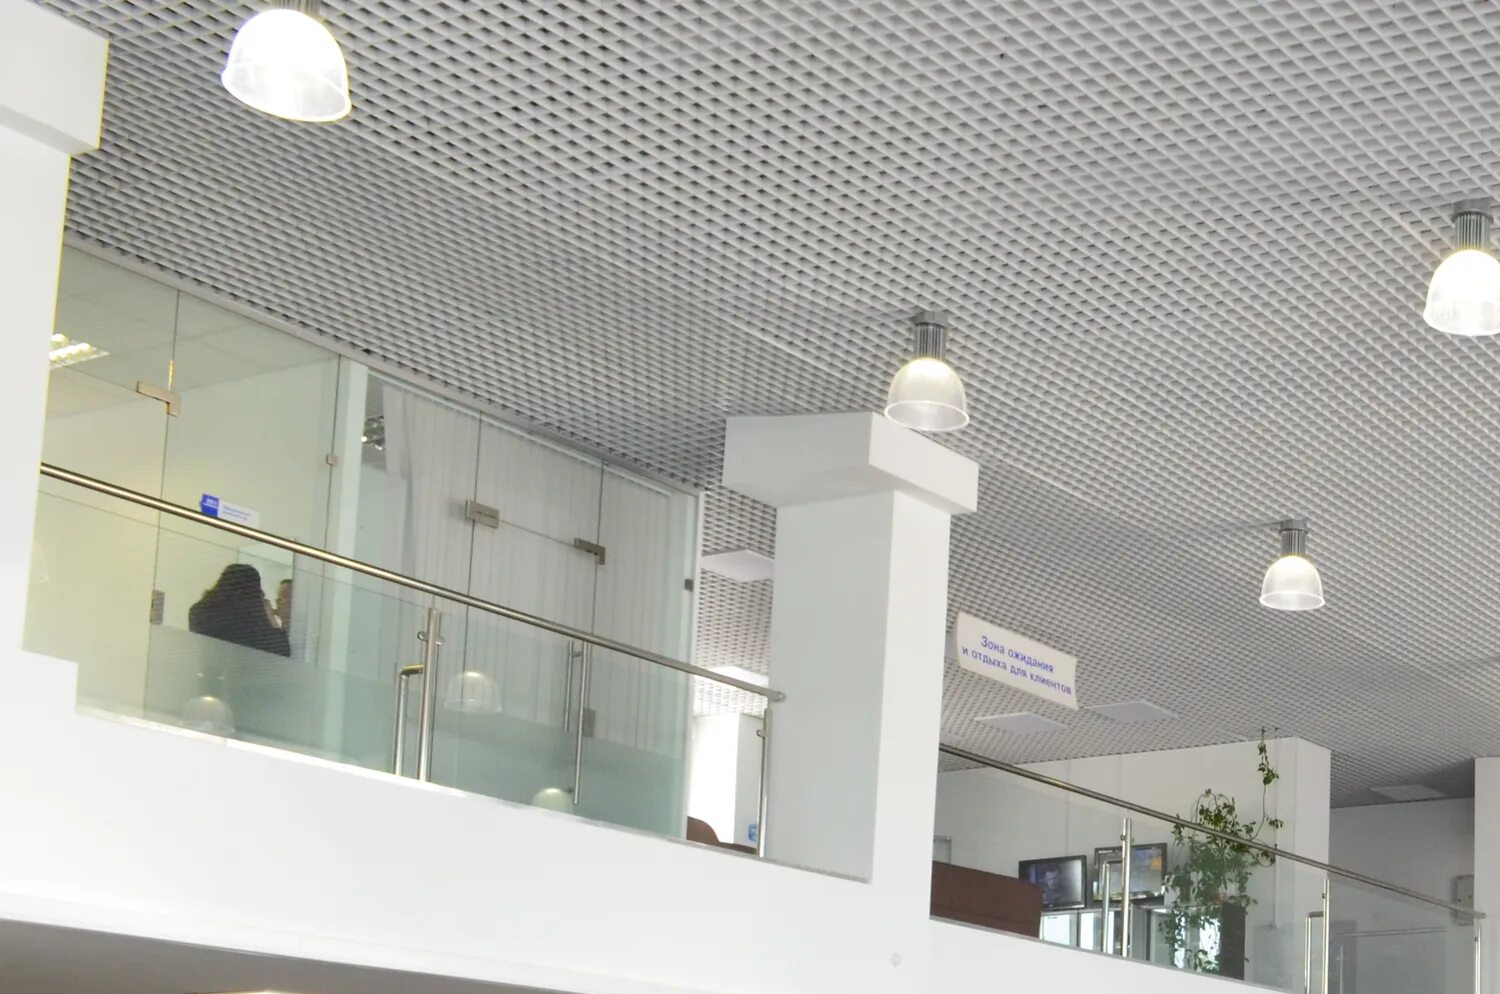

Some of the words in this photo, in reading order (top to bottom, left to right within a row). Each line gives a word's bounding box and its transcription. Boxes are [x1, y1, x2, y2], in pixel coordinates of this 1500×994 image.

[962, 646, 969, 656] и
[971, 651, 1007, 670] отдыха
[1010, 664, 1028, 678] для
[1030, 672, 1072, 695] клиентов
[980, 635, 1005, 654] Зона
[1007, 649, 1054, 673] ожидания
